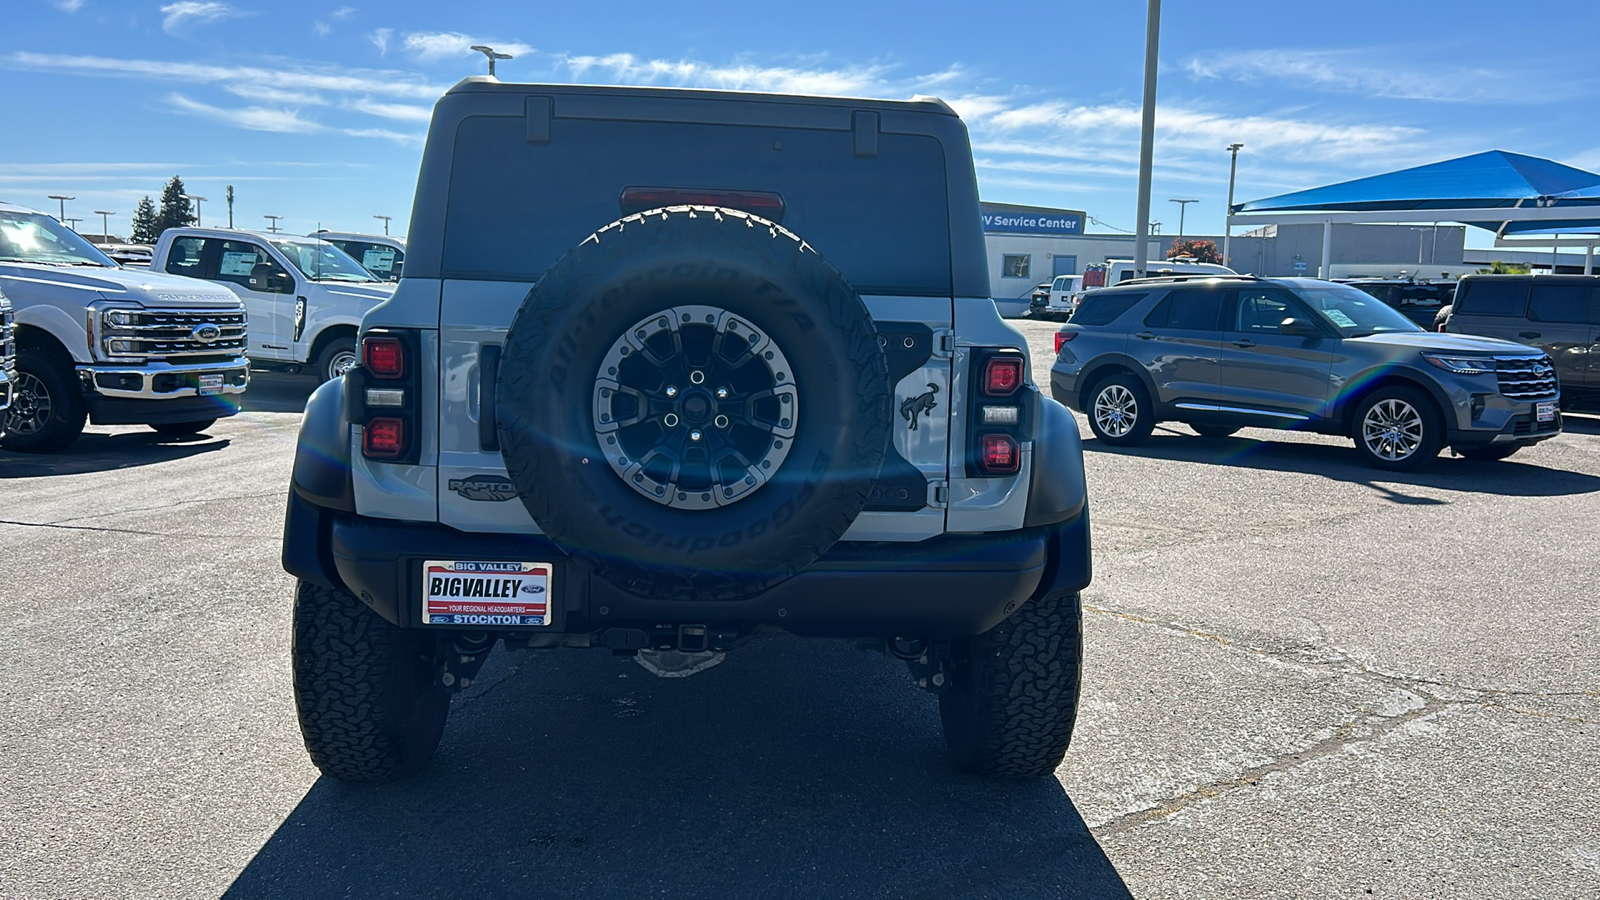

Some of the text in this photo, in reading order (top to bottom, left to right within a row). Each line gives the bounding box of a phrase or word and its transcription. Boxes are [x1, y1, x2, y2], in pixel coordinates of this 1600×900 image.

[981, 215, 1077, 229] V Service Center
[449, 480, 516, 493] RAPTO
[455, 563, 521, 571] BIG VALLEY
[430, 577, 523, 598] BIGVALLEY
[463, 605, 487, 613] REGIONAL
[487, 606, 526, 614] HEADQUARTERS
[453, 614, 521, 624] STOCKTON
